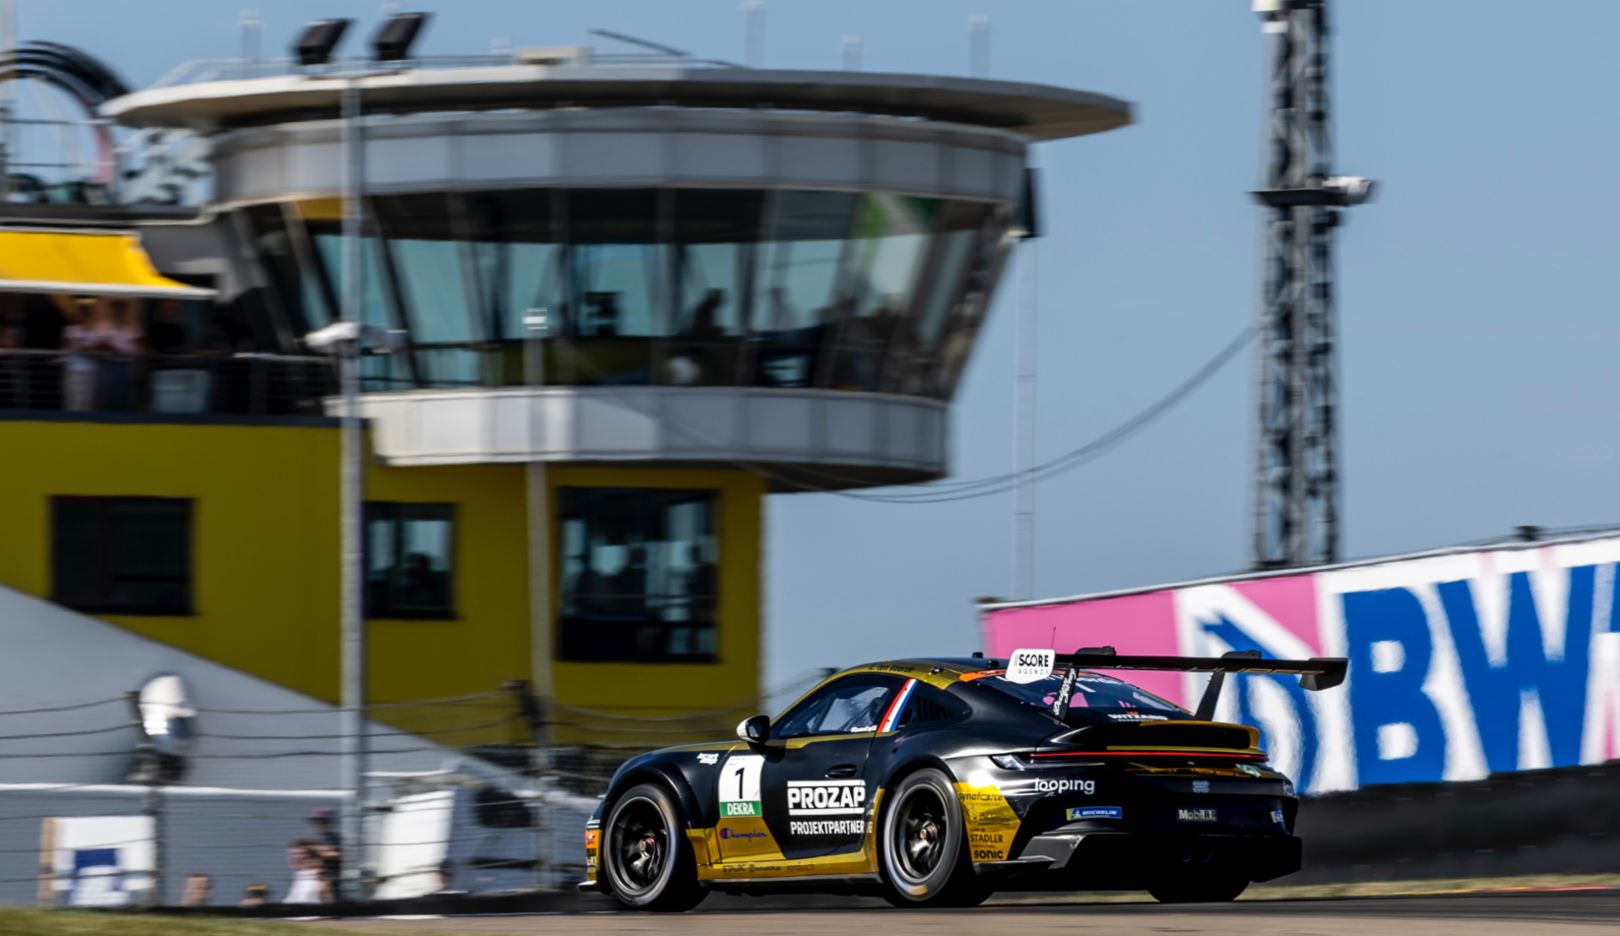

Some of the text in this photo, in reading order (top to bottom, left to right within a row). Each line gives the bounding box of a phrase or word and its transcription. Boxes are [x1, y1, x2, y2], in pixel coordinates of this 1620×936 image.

[1018, 654, 1049, 667] SCORE
[1340, 562, 1620, 786] BW
[734, 767, 745, 800] 1
[1034, 778, 1096, 795] looping
[786, 786, 866, 809] PROZAP
[726, 802, 755, 815] DEKRA
[1178, 809, 1205, 820] Mobil
[719, 827, 768, 842] Champion
[790, 820, 865, 835] PROJEKTPARTNER
[970, 834, 1004, 843] STADLER
